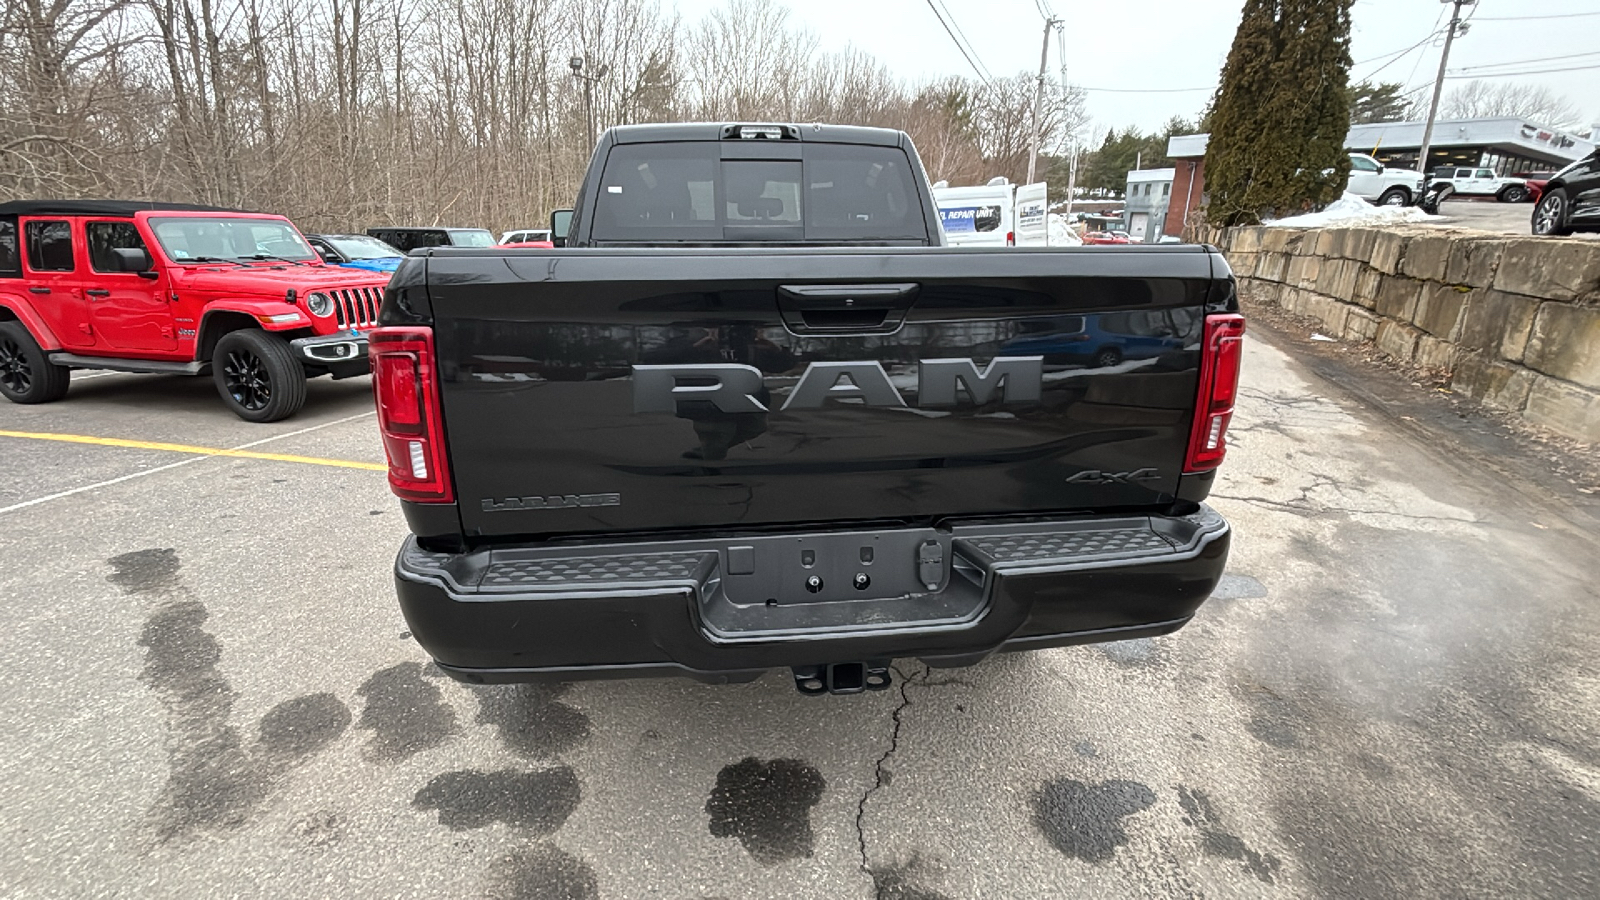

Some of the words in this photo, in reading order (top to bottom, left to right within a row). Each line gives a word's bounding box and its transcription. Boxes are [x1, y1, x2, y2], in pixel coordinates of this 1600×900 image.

[948, 209, 975, 219] REPAIR
[976, 208, 994, 218] UNIT
[632, 356, 1044, 413] RAM
